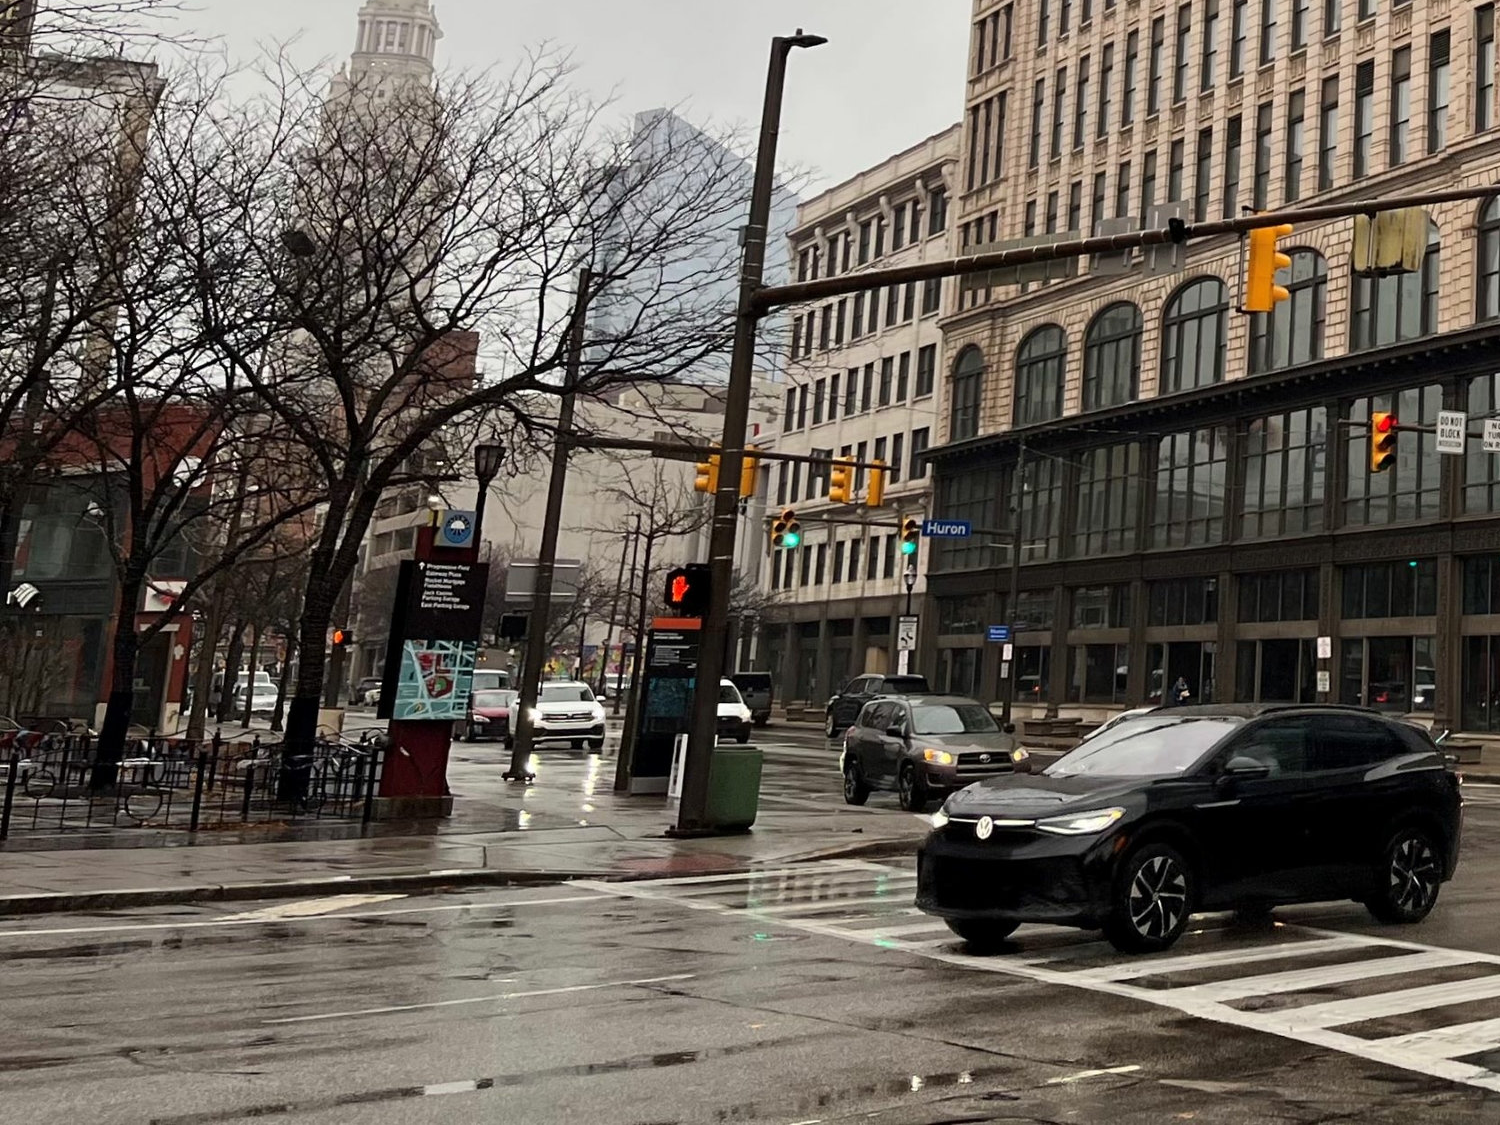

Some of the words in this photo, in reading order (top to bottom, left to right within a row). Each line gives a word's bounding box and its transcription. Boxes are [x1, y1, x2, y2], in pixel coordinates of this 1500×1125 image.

[1440, 416, 1450, 426] DO
[1450, 417, 1463, 427] NOT
[1440, 428, 1461, 438] BLOCK
[926, 521, 967, 536] Huron
